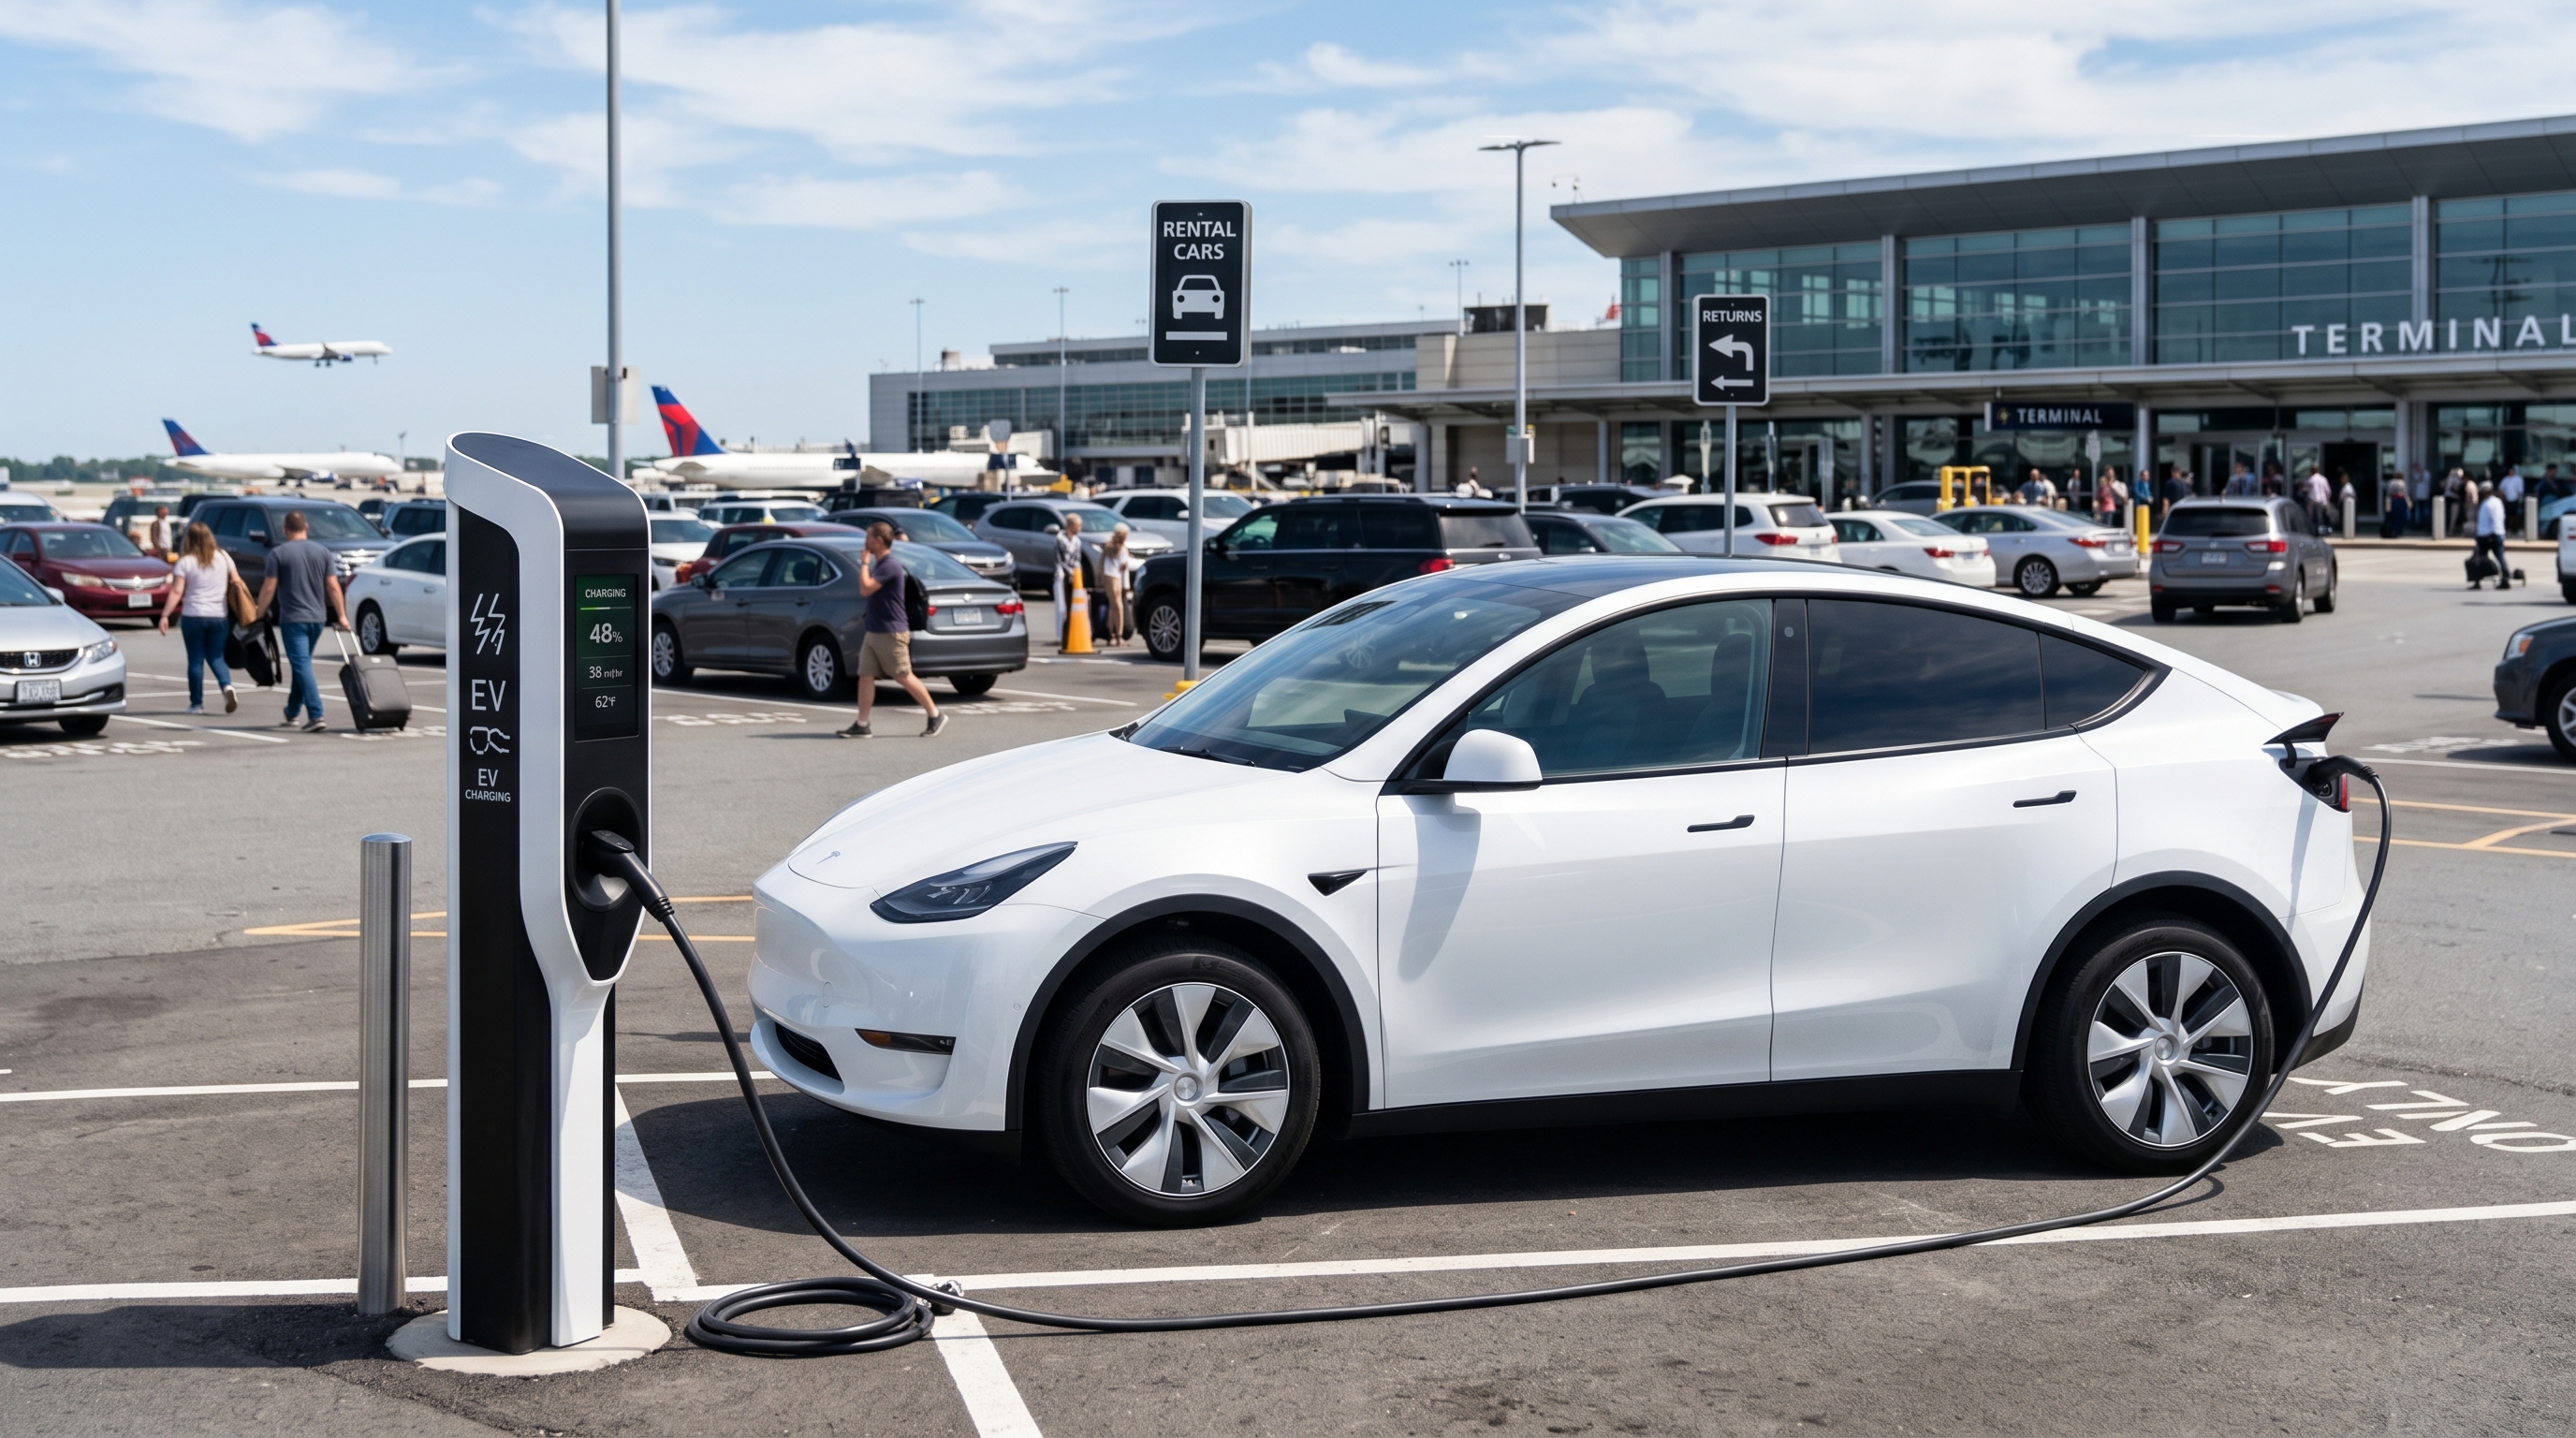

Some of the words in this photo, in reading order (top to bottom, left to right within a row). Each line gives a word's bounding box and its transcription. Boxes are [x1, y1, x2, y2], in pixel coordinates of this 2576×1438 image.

[1164, 221, 1237, 238] RENTAL
[1174, 243, 1224, 260] CARS
[1703, 310, 1763, 323] RETURNS
[2291, 314, 2576, 356] TERMINAL
[2016, 407, 2103, 424] TERMINAL
[585, 588, 626, 598] CHARGING
[589, 623, 623, 644] 48%
[589, 666, 602, 679] 38
[472, 679, 506, 712] EV
[477, 768, 498, 787] EV
[465, 789, 511, 802] CHARGING
